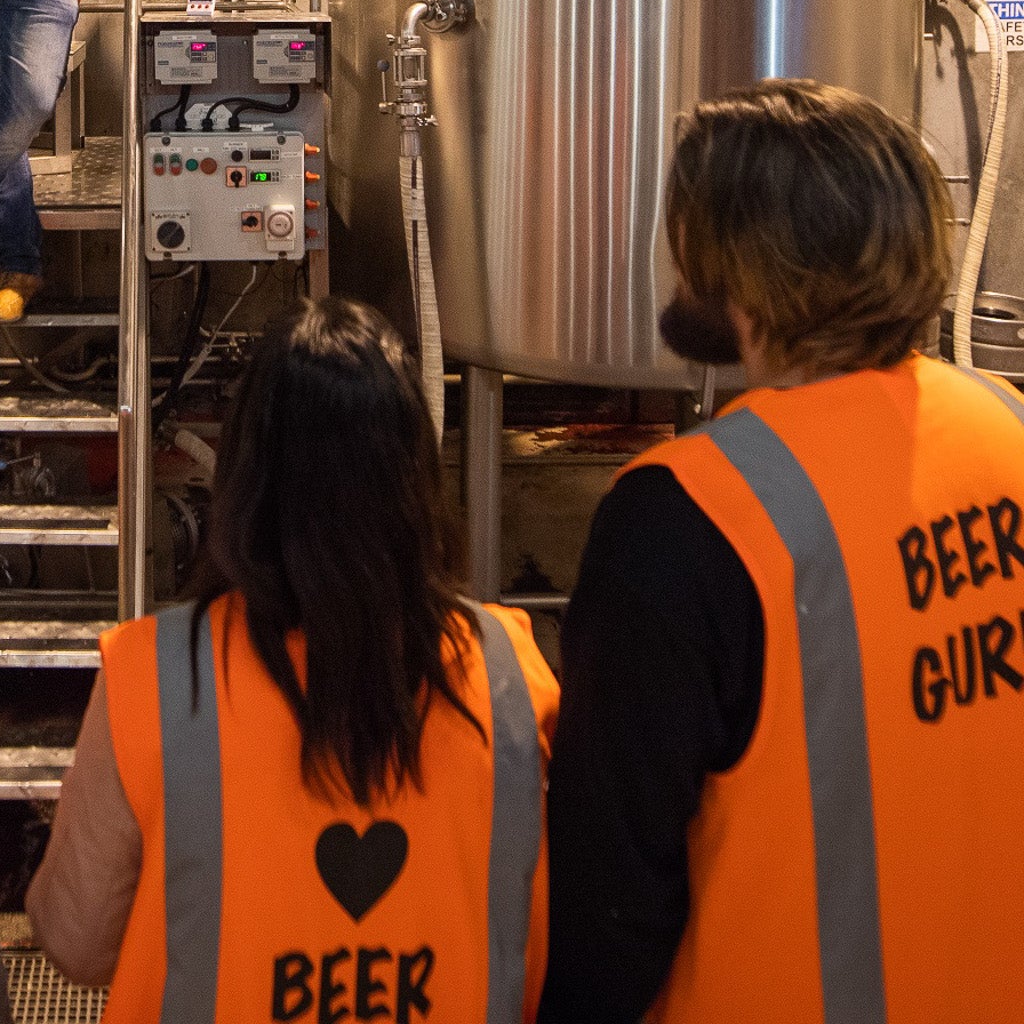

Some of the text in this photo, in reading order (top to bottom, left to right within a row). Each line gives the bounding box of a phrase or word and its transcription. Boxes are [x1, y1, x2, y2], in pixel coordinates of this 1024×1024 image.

[895, 496, 1024, 612] BEER
[909, 609, 1024, 724] GUR
[271, 943, 436, 1024] BEER
